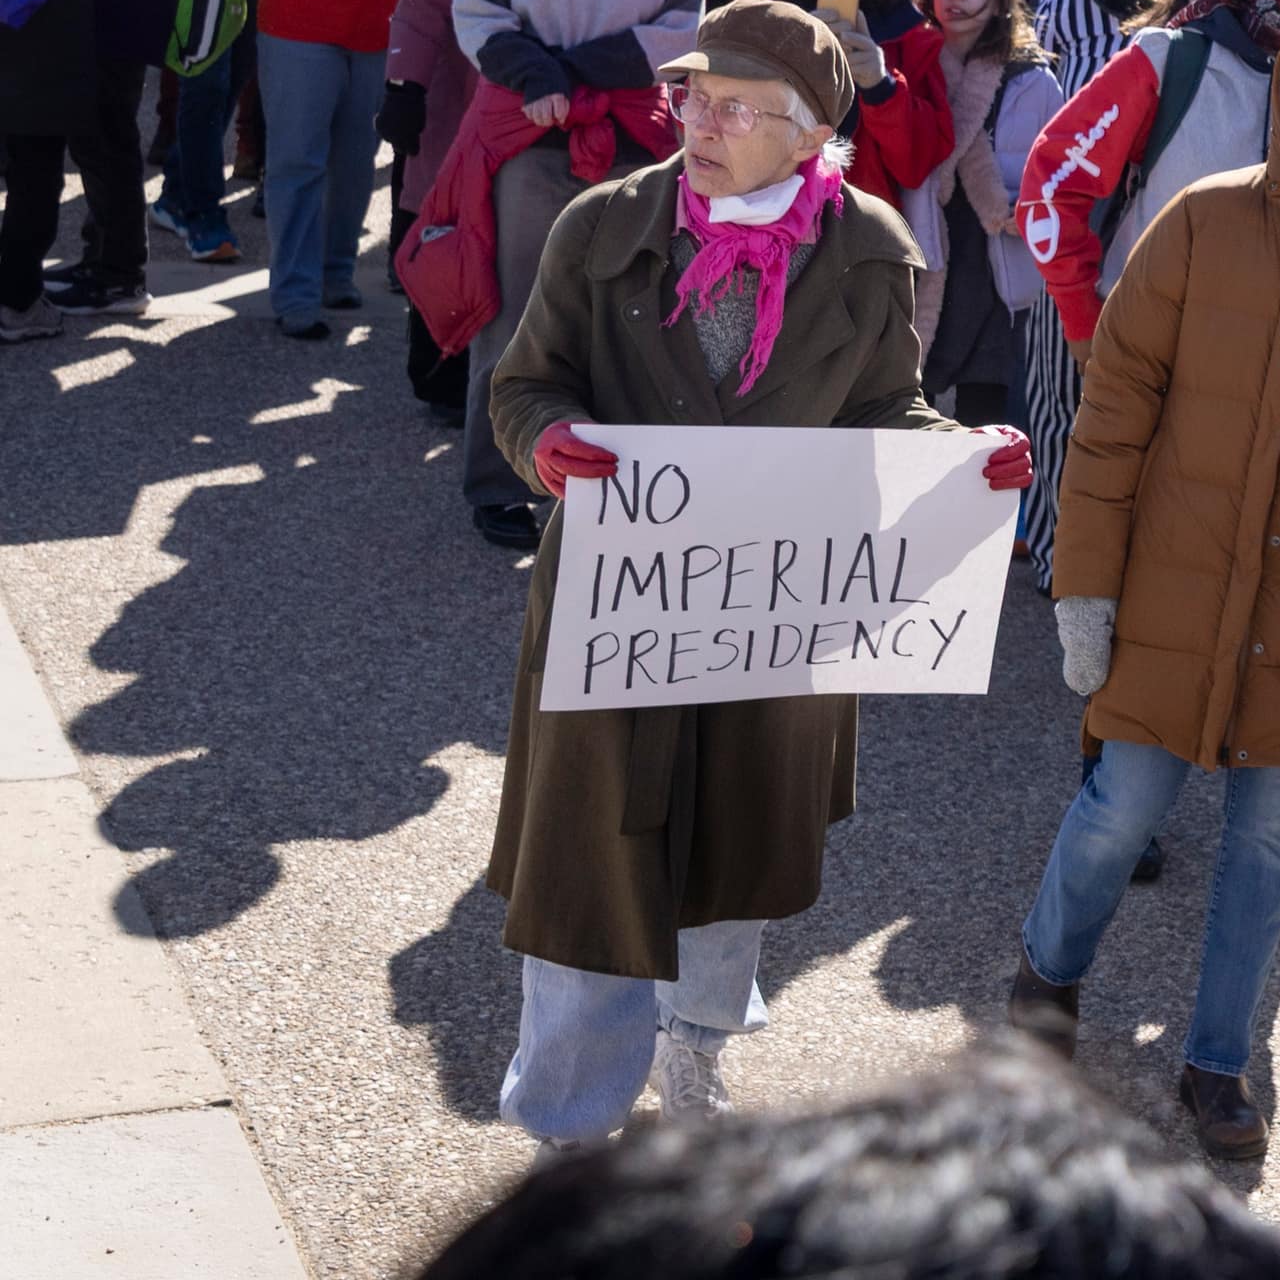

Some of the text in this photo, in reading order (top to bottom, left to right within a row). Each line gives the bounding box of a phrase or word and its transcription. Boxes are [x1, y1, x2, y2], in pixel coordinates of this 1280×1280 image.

[1020, 103, 1120, 264] Champion
[598, 459, 691, 525] NO
[589, 532, 931, 620] IMPERIAL
[583, 608, 968, 695] PRESIDENCY
